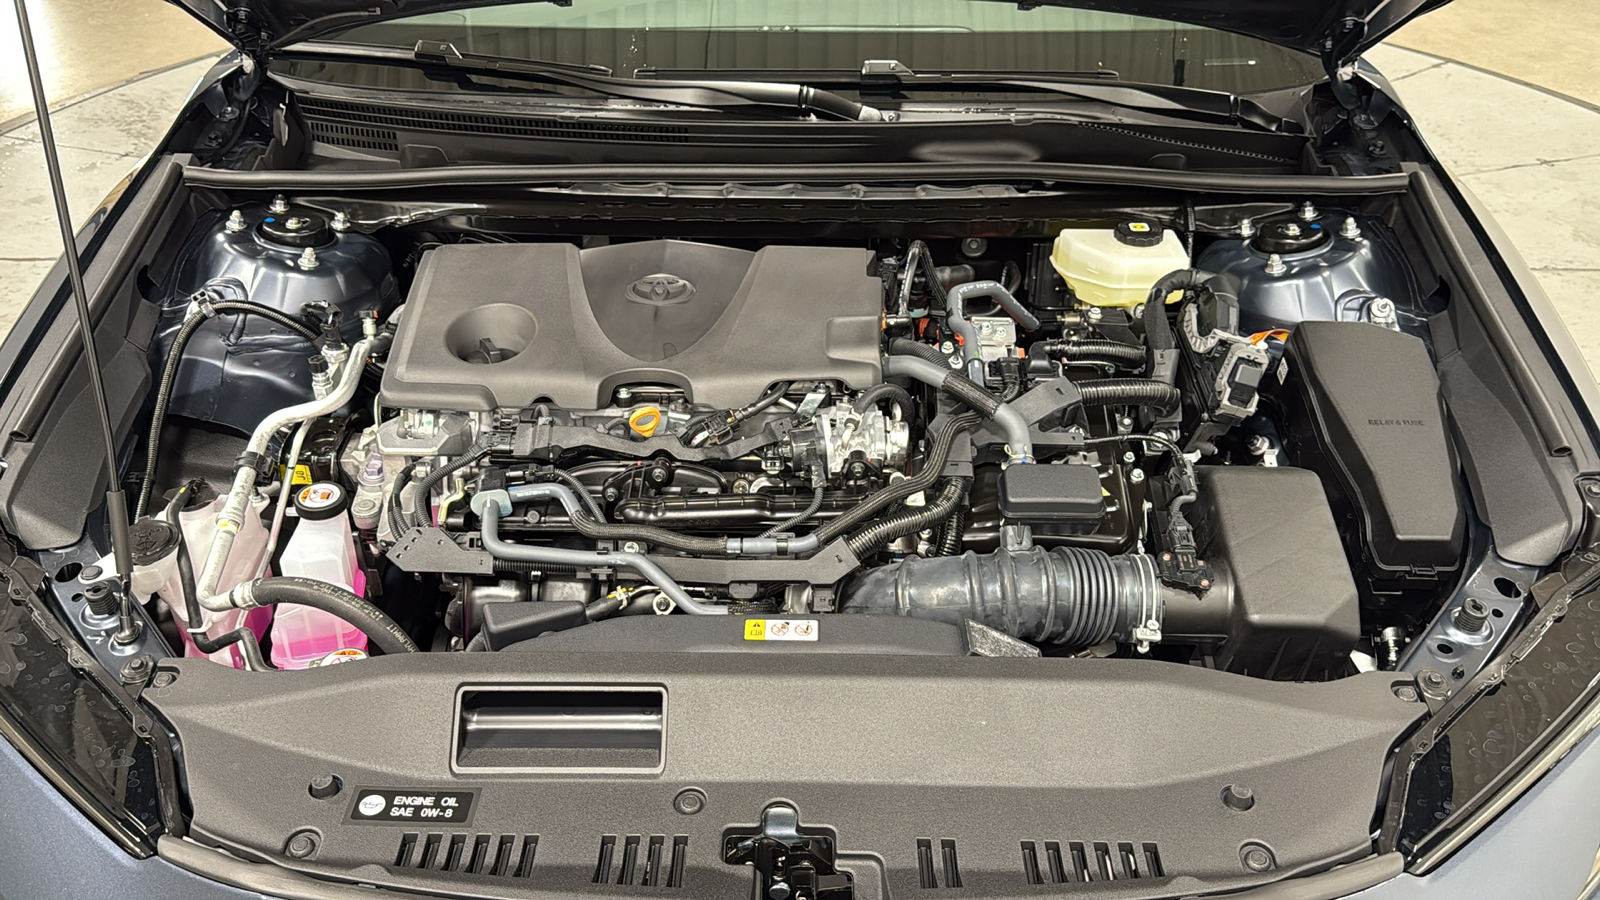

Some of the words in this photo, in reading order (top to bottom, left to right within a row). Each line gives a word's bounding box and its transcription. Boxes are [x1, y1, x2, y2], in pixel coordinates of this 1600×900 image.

[393, 796, 435, 806] ENGINE
[441, 797, 459, 807] OIL
[390, 807, 414, 817] SAE
[420, 808, 453, 818] 0W-8
